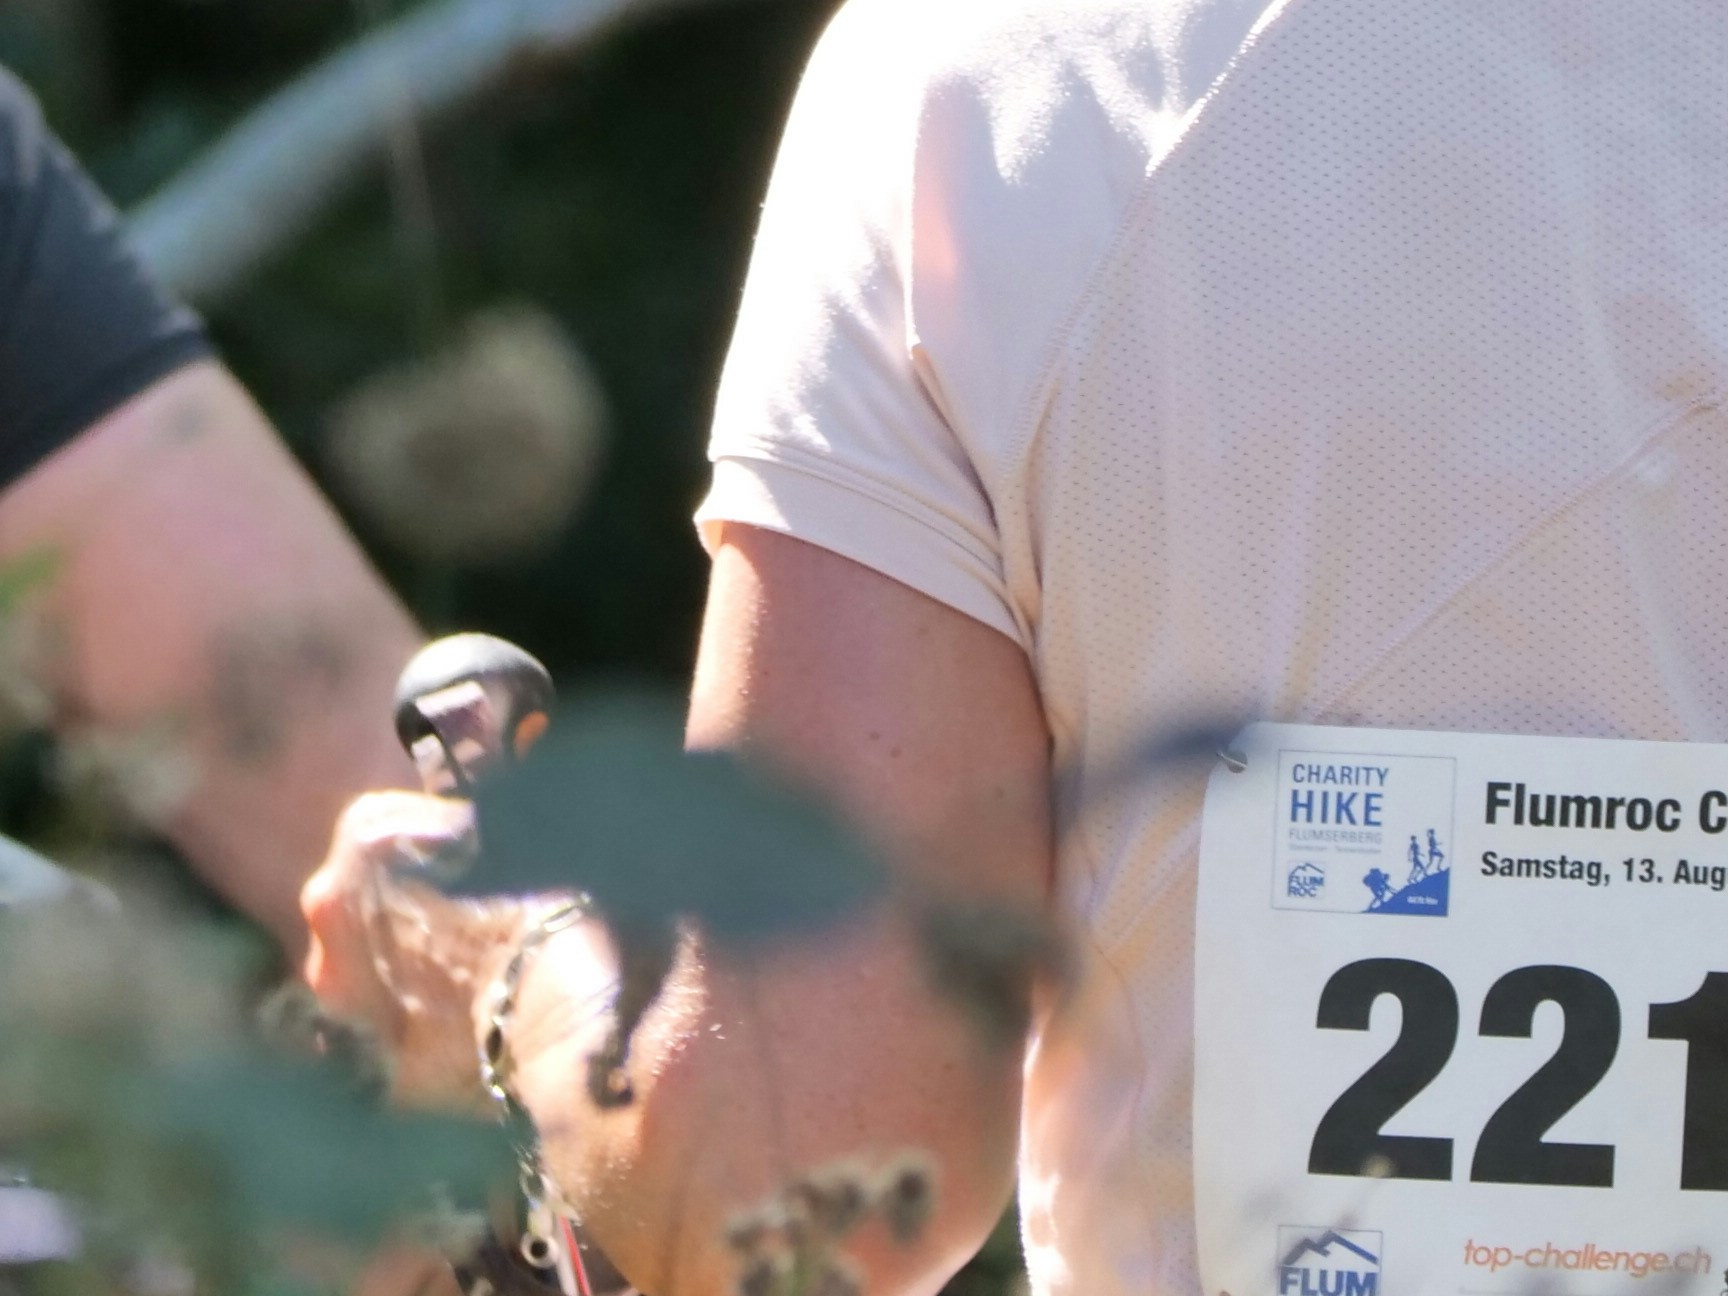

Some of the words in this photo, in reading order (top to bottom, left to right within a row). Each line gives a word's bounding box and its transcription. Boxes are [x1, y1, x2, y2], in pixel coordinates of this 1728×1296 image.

[1292, 763, 1389, 787] CHARITY
[1290, 789, 1384, 827] HIKE
[1484, 781, 1682, 832] Flumroc
[1288, 828, 1383, 845] FLUMSERBERG
[1480, 851, 1611, 887] Samstag,
[1622, 857, 1664, 884] 13.
[1463, 1238, 1713, 1280] top-challenge.ch
